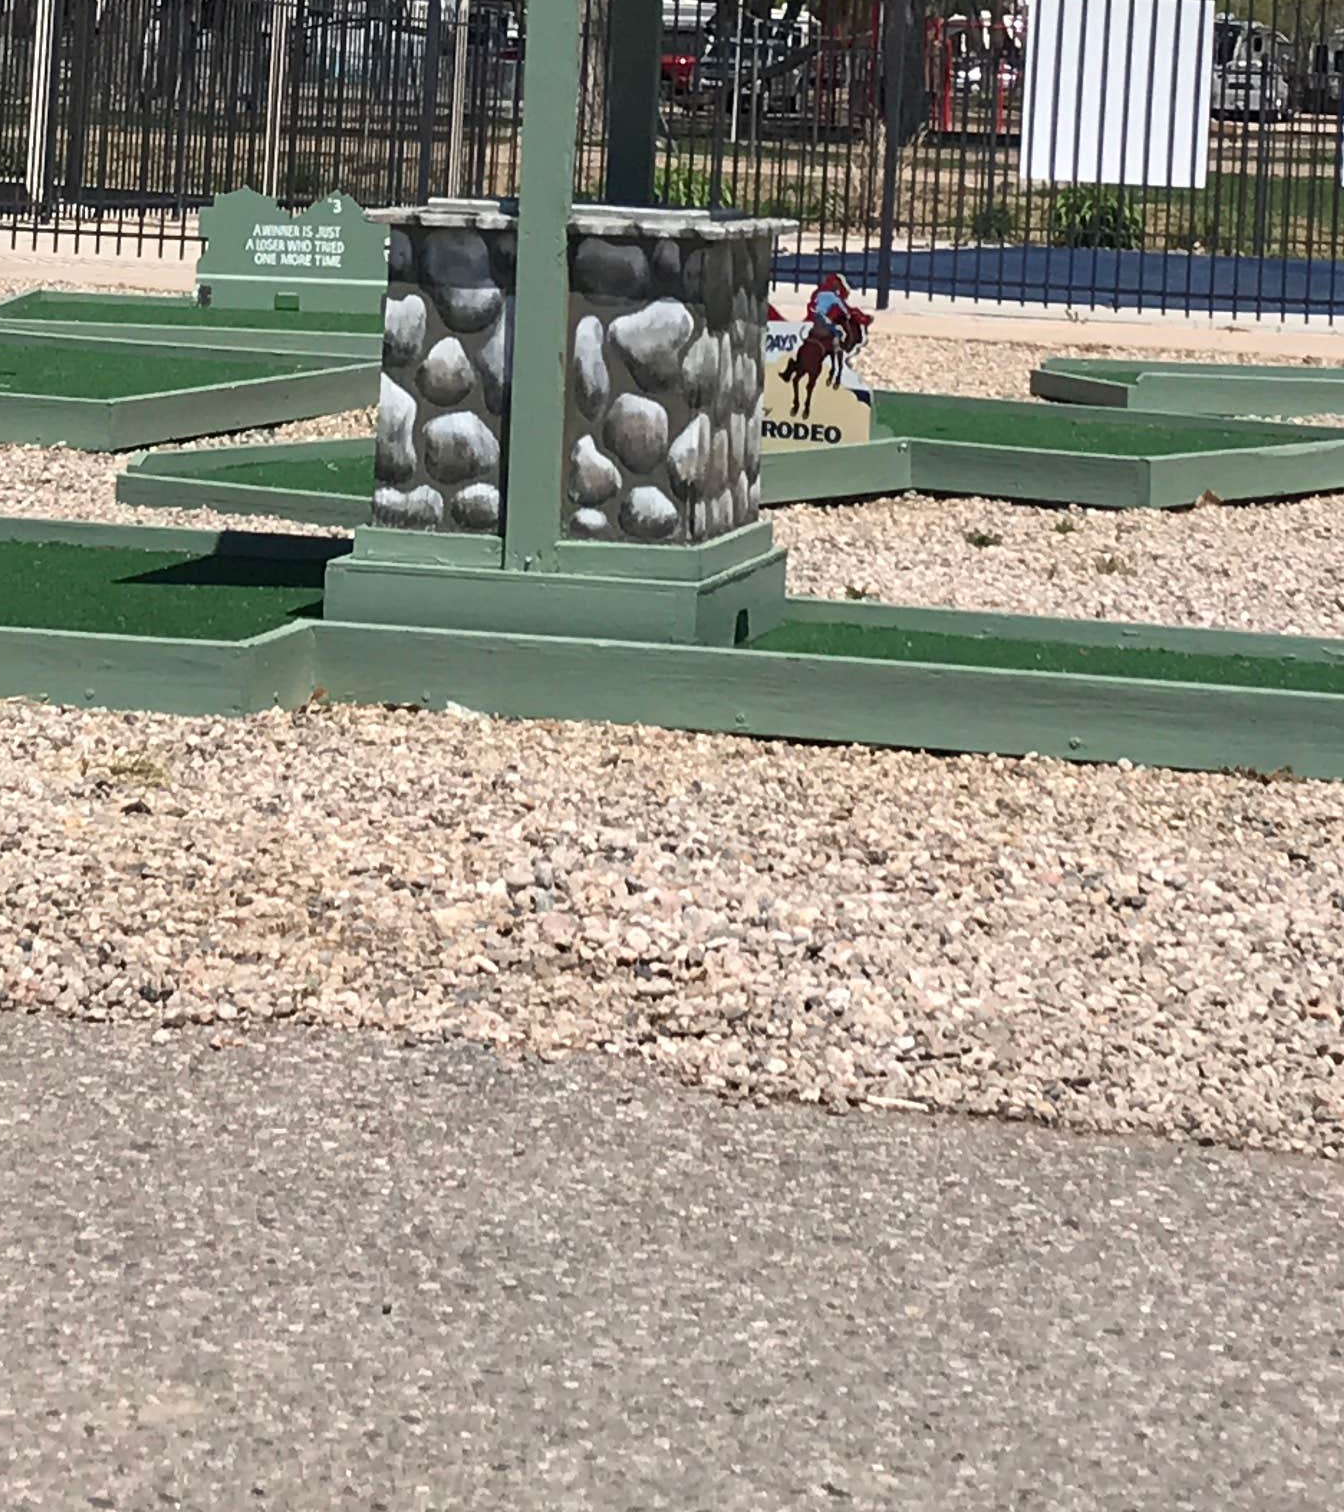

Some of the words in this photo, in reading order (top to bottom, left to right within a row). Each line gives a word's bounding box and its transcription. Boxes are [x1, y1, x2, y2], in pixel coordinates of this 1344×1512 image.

[302, 225, 313, 238] IS
[315, 226, 341, 239] JUST
[245, 238, 254, 251] A
[256, 239, 285, 251] LOSER
[287, 240, 312, 252] WHO
[314, 241, 345, 254] TRIED
[254, 252, 277, 265] ONE
[280, 253, 312, 266] MORE
[314, 255, 342, 268] TIME
[760, 420, 842, 444] RODEO
